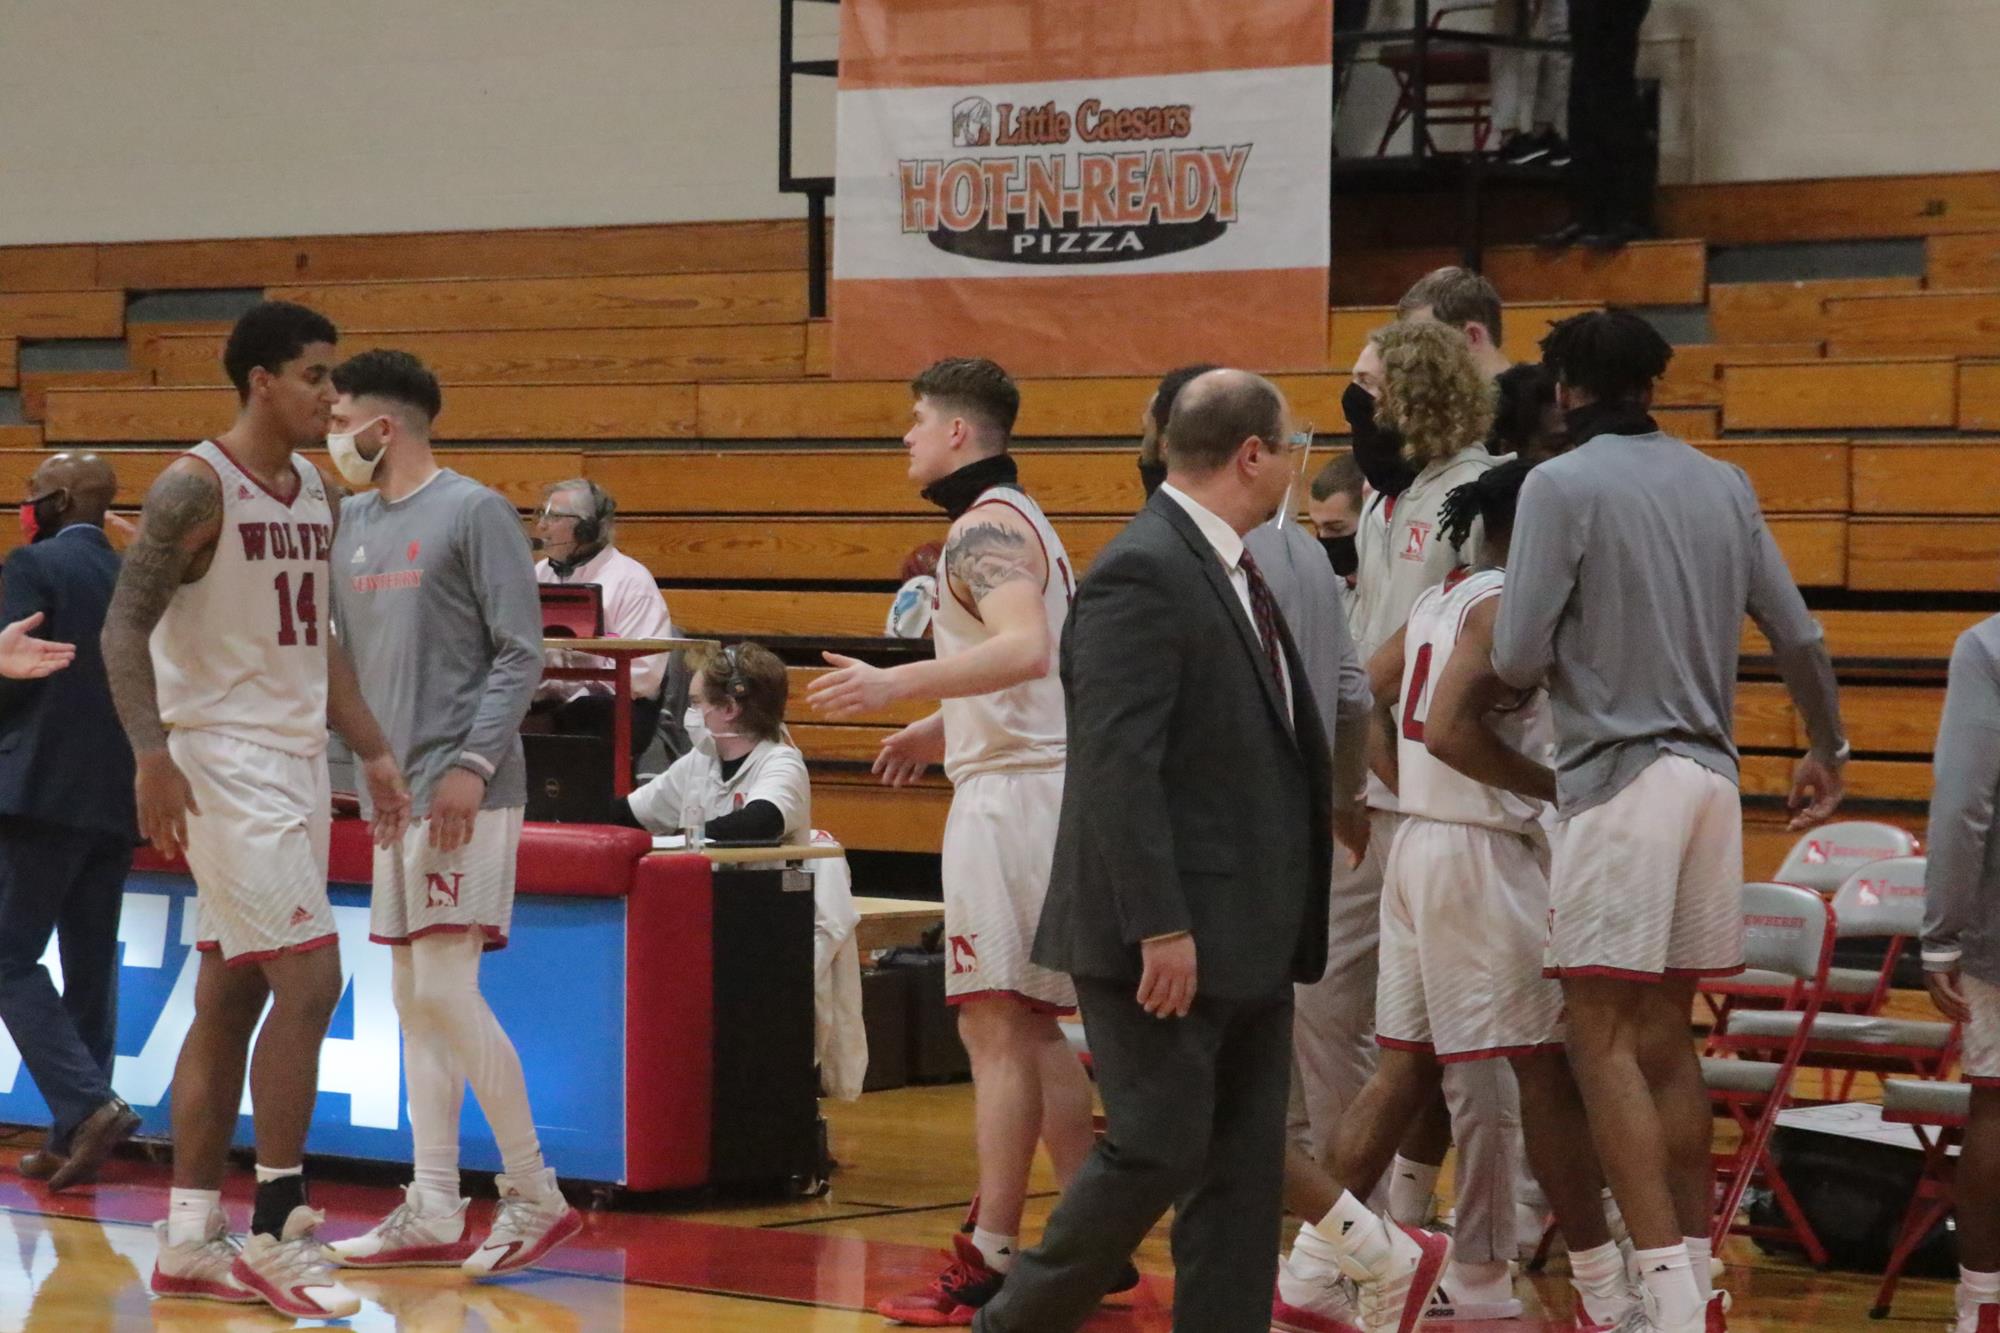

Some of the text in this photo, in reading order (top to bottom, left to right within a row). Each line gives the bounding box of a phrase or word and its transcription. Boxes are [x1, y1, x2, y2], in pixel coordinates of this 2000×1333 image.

[996, 98, 1192, 145] Little Caesars
[900, 143, 1253, 233] HOT-N-READY
[1013, 230, 1144, 254] PIZZA
[274, 571, 318, 645] 14
[425, 872, 465, 909] N
